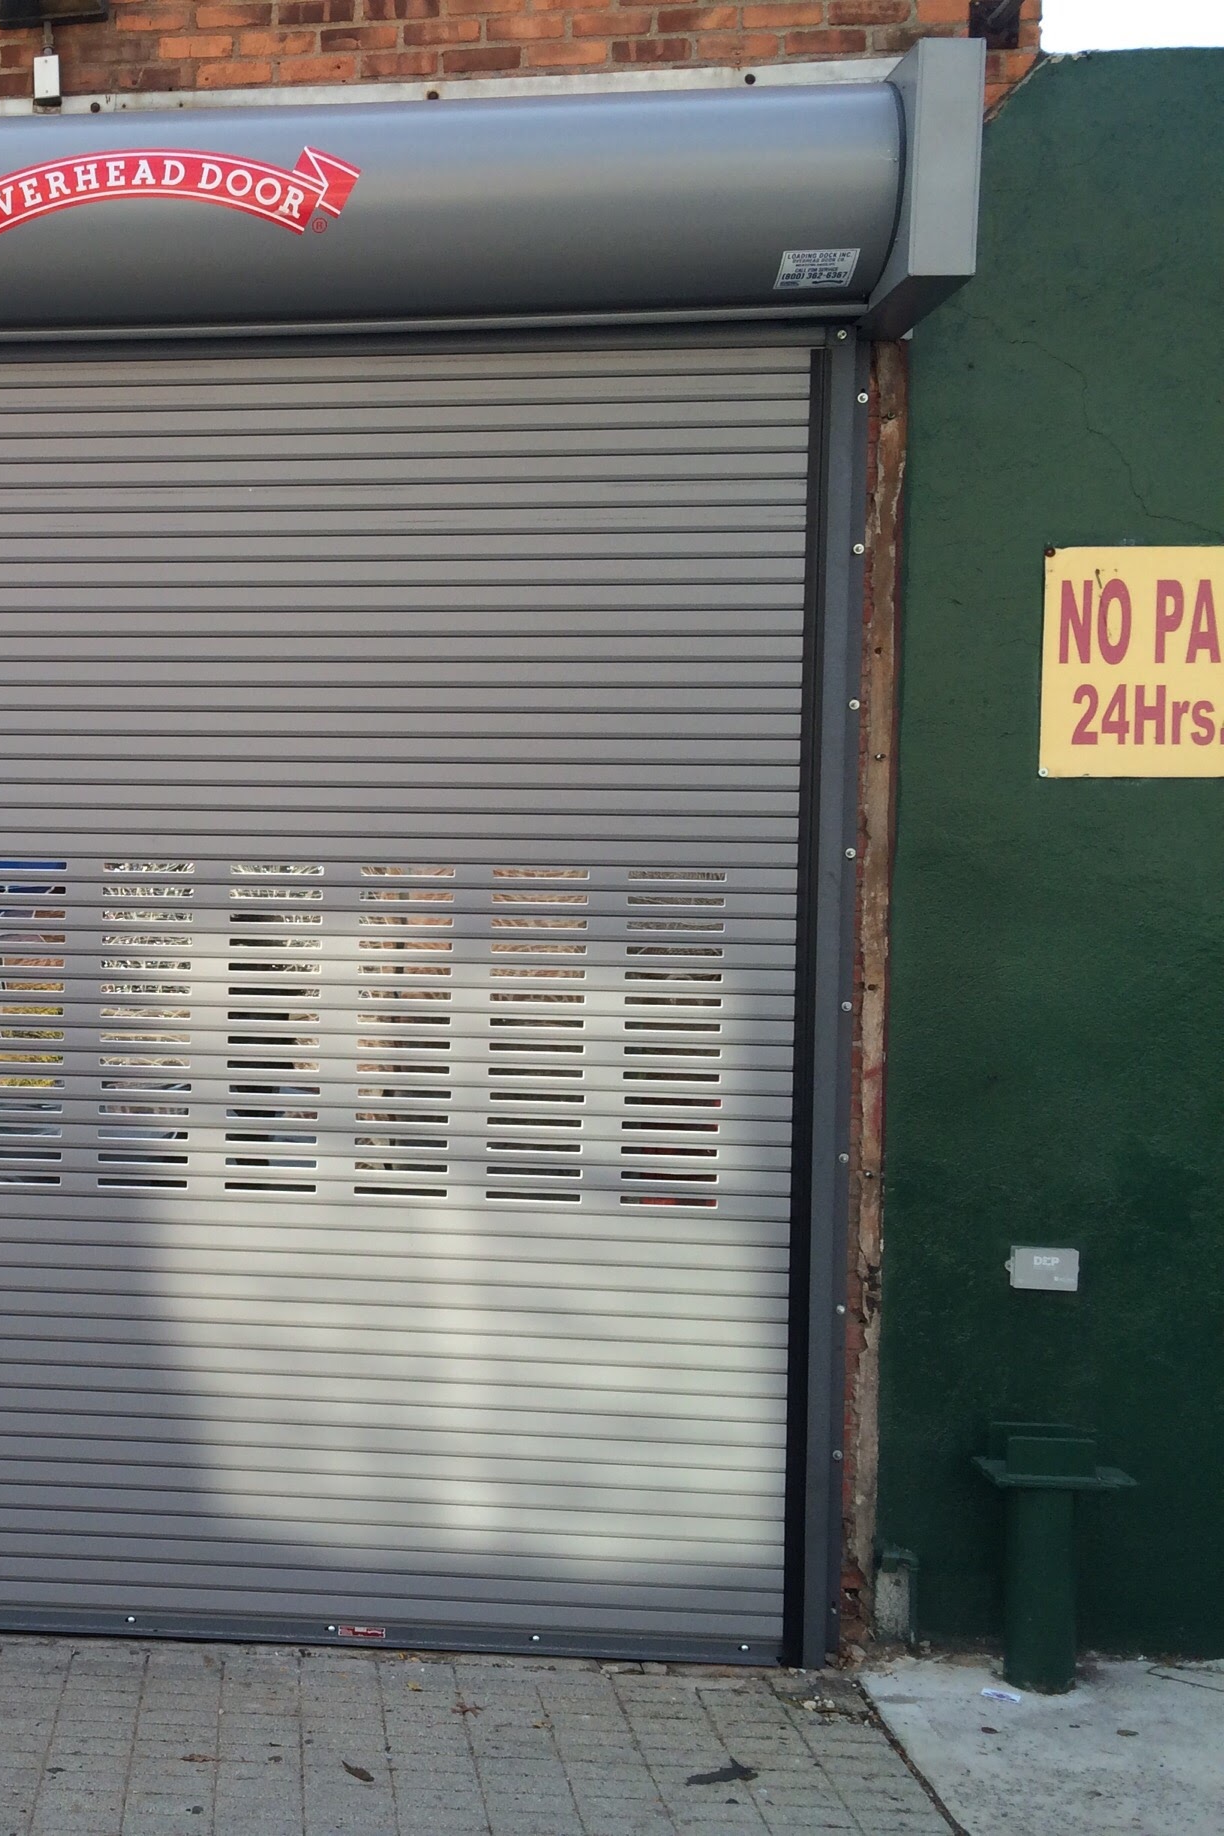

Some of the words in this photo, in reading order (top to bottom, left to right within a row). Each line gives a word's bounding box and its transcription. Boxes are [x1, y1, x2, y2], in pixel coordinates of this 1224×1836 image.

[197, 162, 305, 219] DOOR
[1058, 578, 1132, 665] NO
[1154, 578, 1222, 664] PA
[1033, 1255, 1060, 1267] DEP
